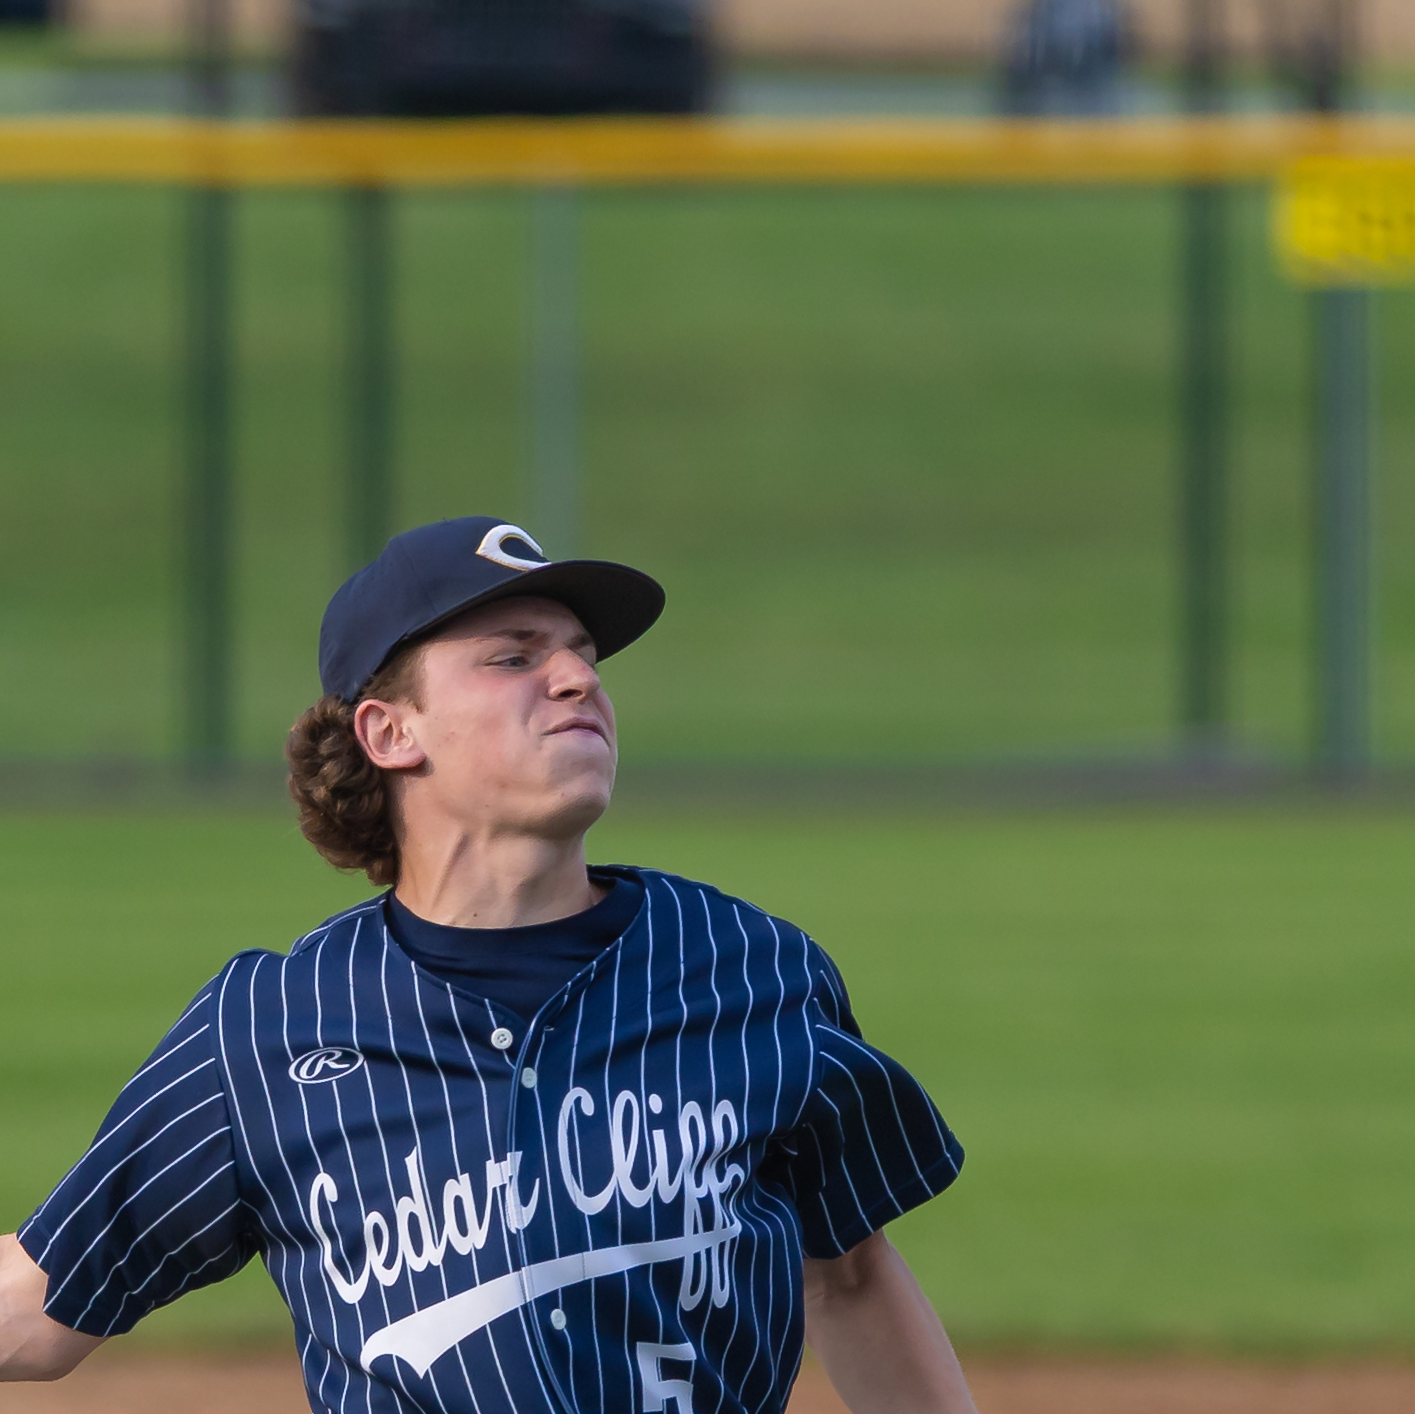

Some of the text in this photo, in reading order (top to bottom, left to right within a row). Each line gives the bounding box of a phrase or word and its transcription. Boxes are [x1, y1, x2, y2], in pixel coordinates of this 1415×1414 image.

[475, 523, 553, 572] C
[309, 1085, 749, 1312] Cedar Cliff
